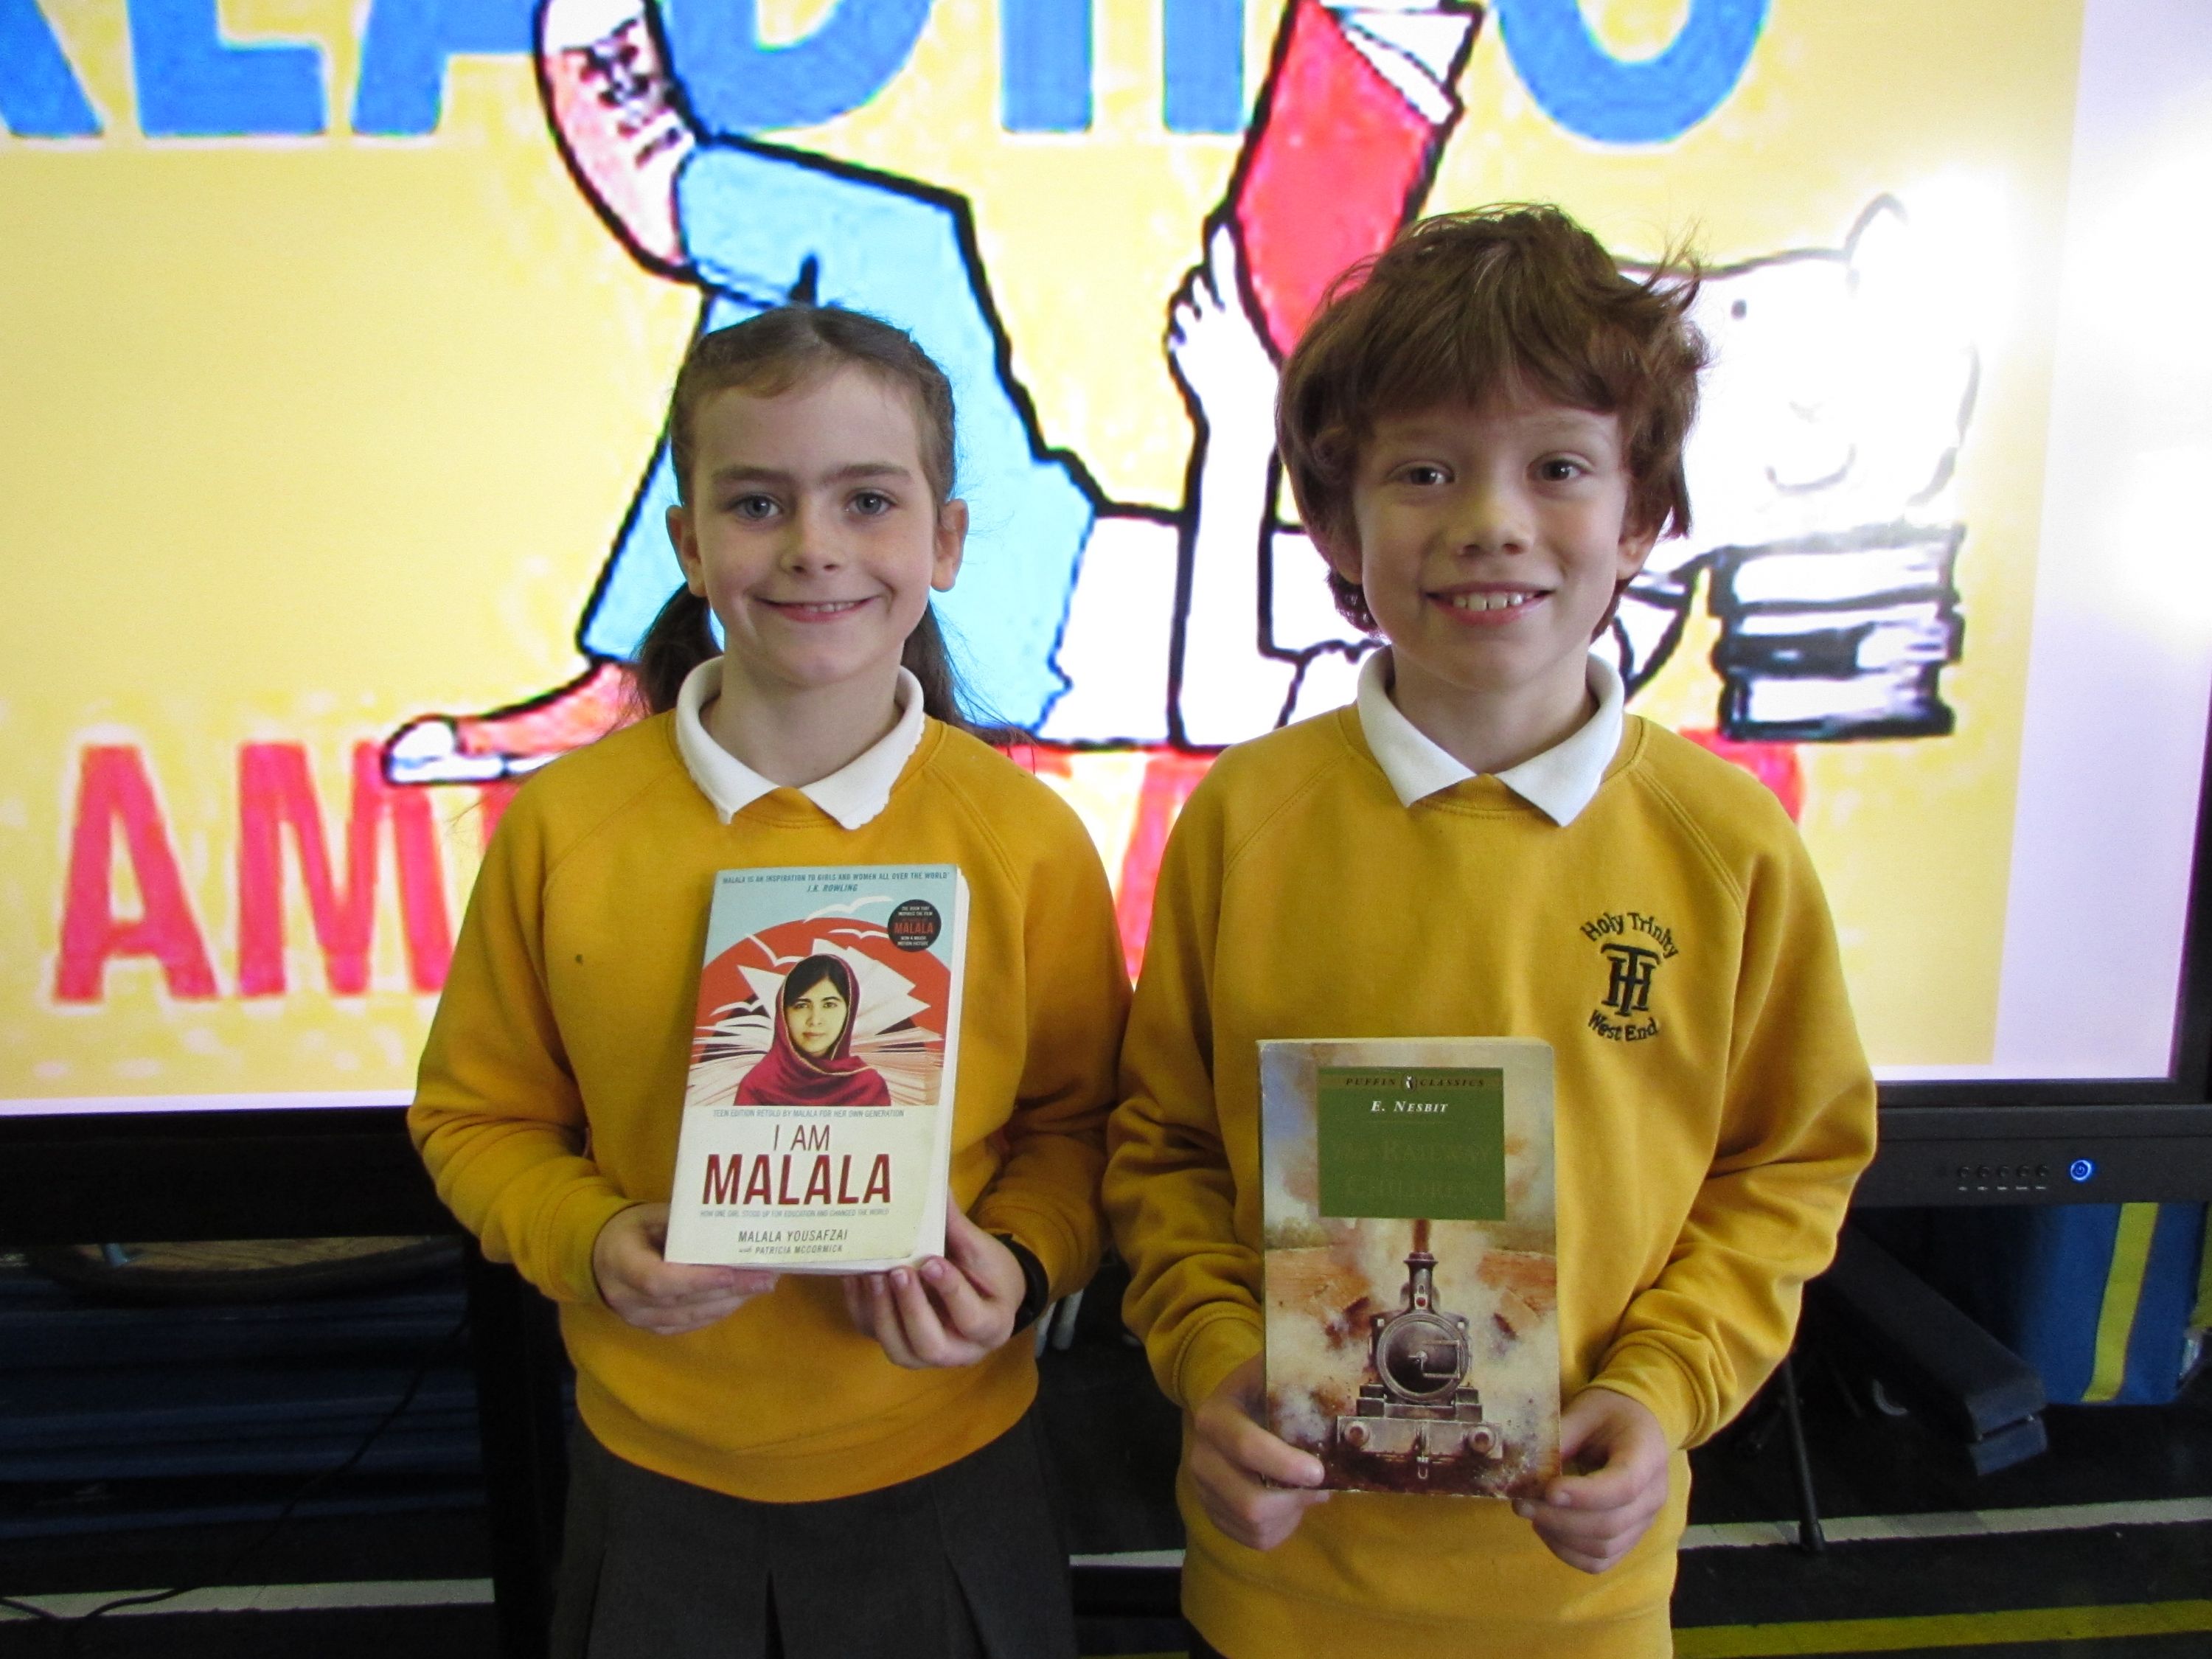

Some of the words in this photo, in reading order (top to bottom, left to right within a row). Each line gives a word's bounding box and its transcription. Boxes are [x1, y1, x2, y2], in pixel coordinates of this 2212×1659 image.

[823, 884, 858, 892] ROWLING
[894, 922, 934, 934] MALALA
[1579, 911, 1624, 942] Holy
[1627, 912, 1679, 959] Trinity
[1587, 1009, 1622, 1041] West
[1624, 1017, 1659, 1042] End
[1346, 1077, 1397, 1086] PUFFIN
[1420, 1079, 1484, 1087] CLASSICS
[1371, 1100, 1385, 1112] E.
[713, 1109, 729, 1117] TEEN
[731, 1109, 754, 1117] EDITION
[756, 1109, 781, 1117] RETOLD
[782, 1109, 791, 1117] BY
[793, 1109, 817, 1117] MALALA
[773, 1124, 779, 1151] I
[790, 1124, 830, 1151] AM
[702, 1153, 891, 1206] MALALA
[738, 1231, 782, 1242] MALALA
[787, 1229, 848, 1242] YOUSAFZAI
[755, 1245, 791, 1254] PATRICIA
